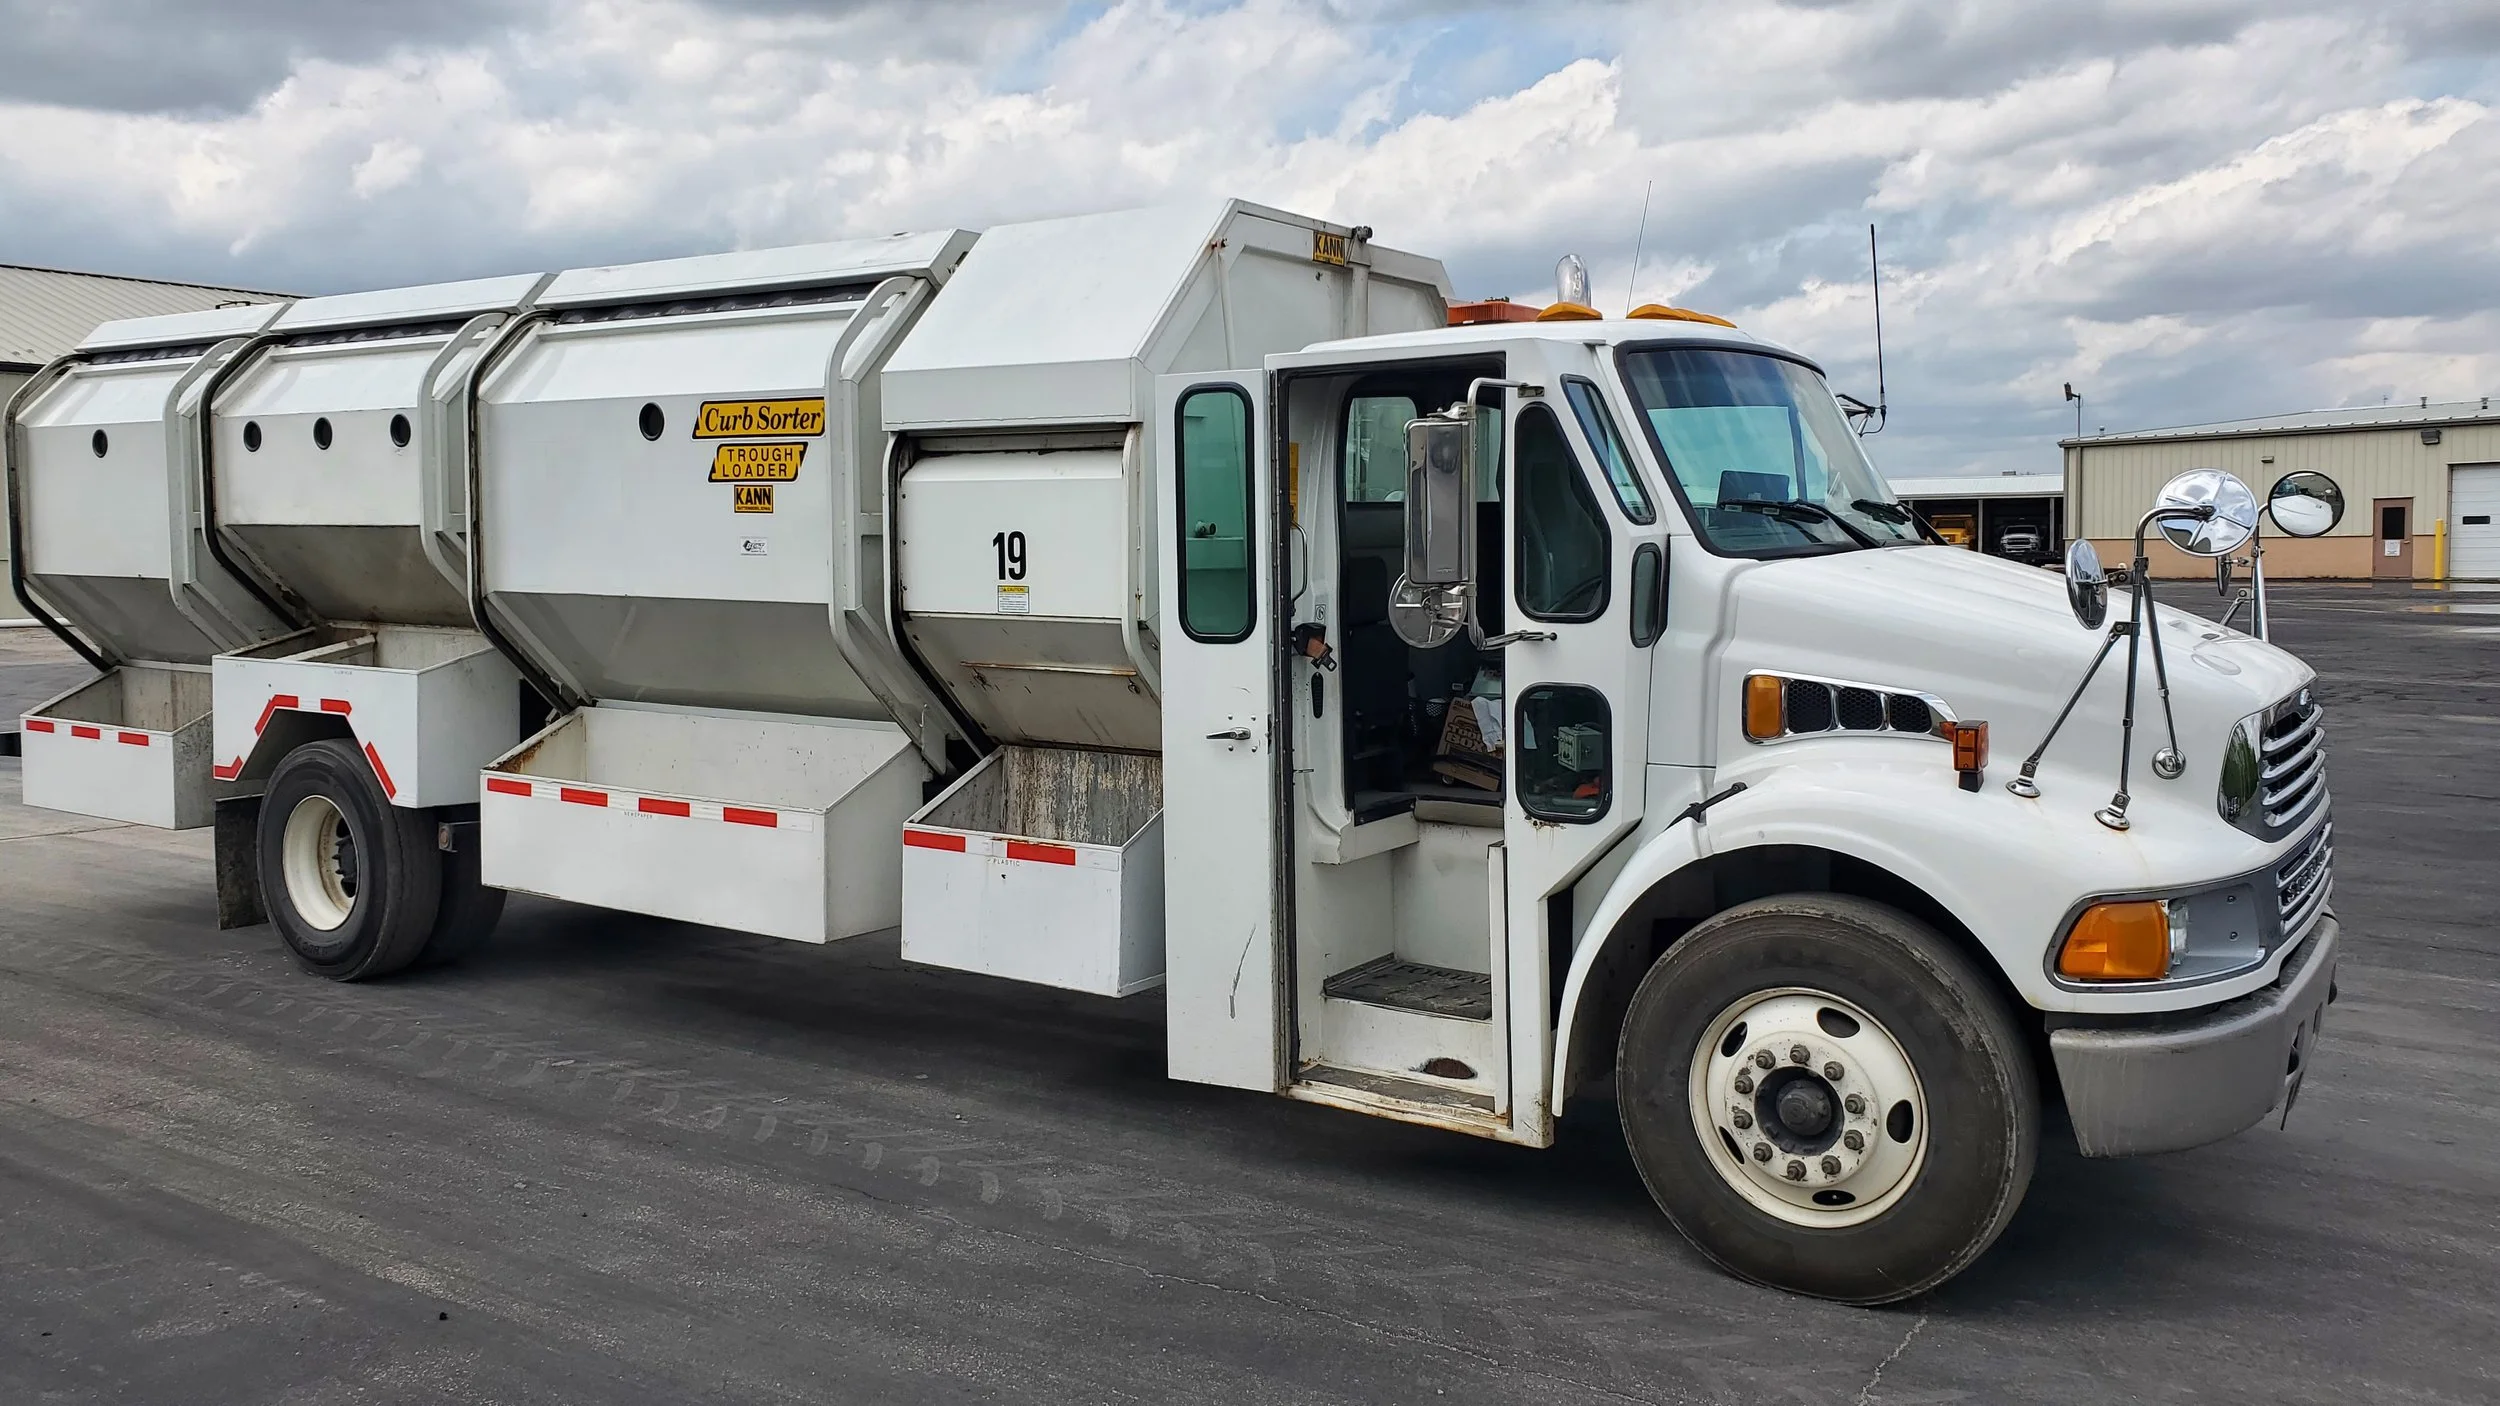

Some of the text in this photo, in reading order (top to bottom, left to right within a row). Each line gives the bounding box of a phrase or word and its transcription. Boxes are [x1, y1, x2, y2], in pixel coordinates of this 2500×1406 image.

[1315, 232, 1344, 259] KANN
[705, 405, 821, 432] Curb Sorter
[727, 448, 793, 462] TROUGH
[722, 464, 787, 477] LOADER
[736, 488, 771, 505] KANN
[992, 530, 1027, 581] 19
